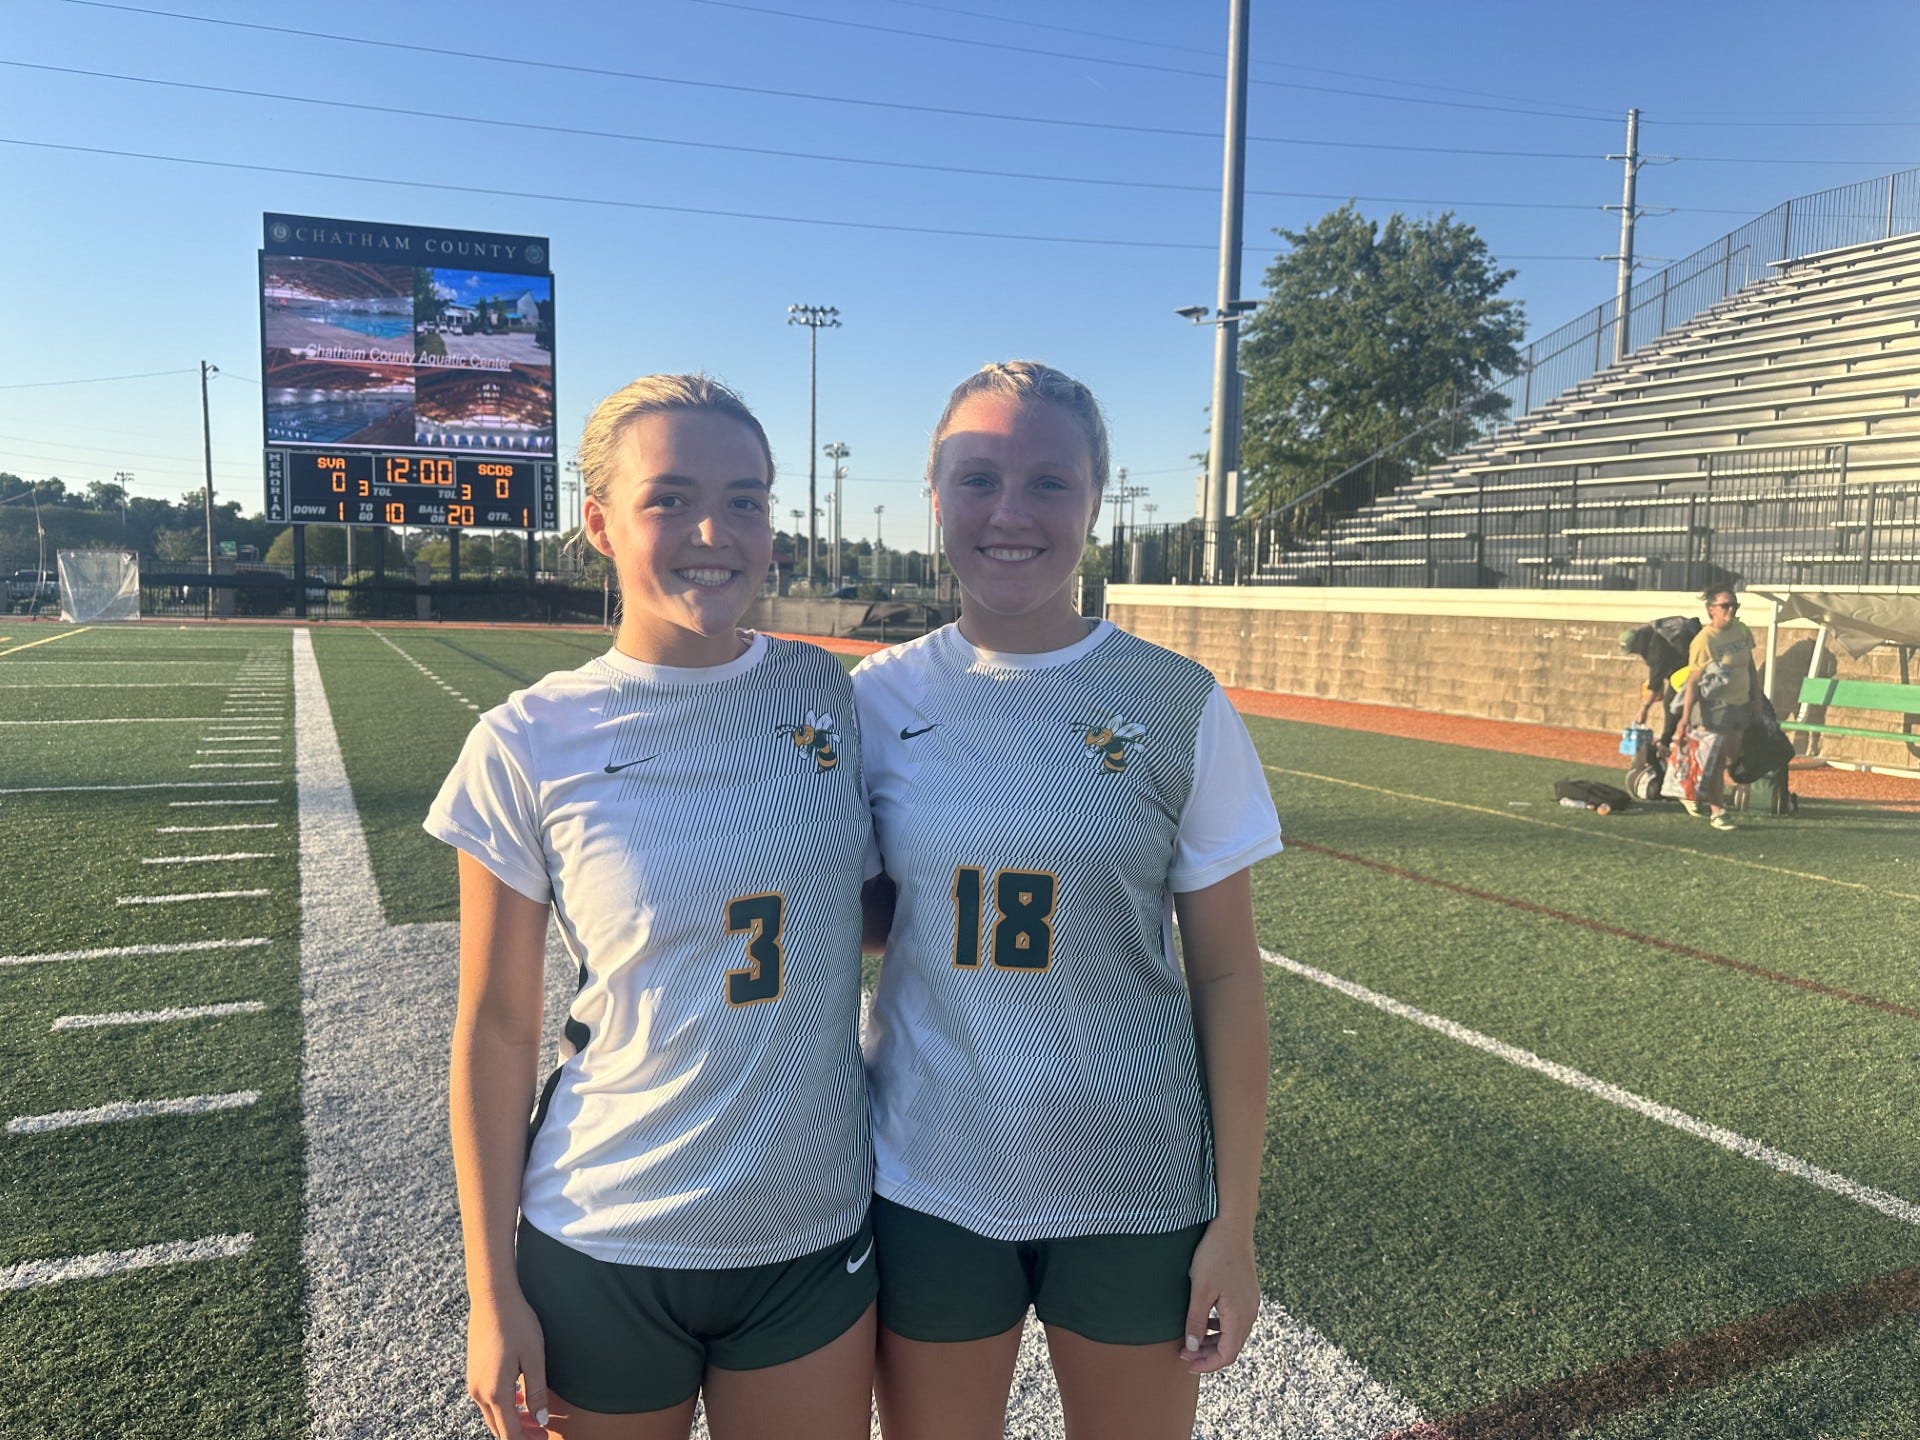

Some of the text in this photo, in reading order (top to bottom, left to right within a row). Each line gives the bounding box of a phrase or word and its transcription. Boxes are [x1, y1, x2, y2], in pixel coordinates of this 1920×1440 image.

[296, 227, 517, 259] CHATHAM COUNTY
[306, 343, 513, 370] Chatham County Aquatic Center
[317, 456, 346, 470] SVA
[386, 458, 453, 485] 12:00
[478, 463, 513, 477] SCDS
[269, 453, 281, 520] MEMORIAL
[332, 472, 346, 493] 0
[358, 480, 369, 497] 3
[373, 487, 393, 497] TOL
[496, 478, 509, 499] 0
[438, 489, 458, 500] TOL
[461, 484, 472, 501] 3
[543, 464, 555, 529] STADIUM
[293, 505, 326, 515] DOWN
[338, 502, 345, 522] 1
[358, 511, 374, 522] GO
[359, 502, 373, 512] TO
[385, 502, 405, 524] 10
[418, 504, 445, 515] BALL
[447, 504, 475, 526] 20
[487, 511, 512, 522] QTR.
[430, 513, 446, 524] ON
[522, 508, 529, 527] 1
[952, 865, 1058, 974] 18
[724, 891, 786, 1009] 3
